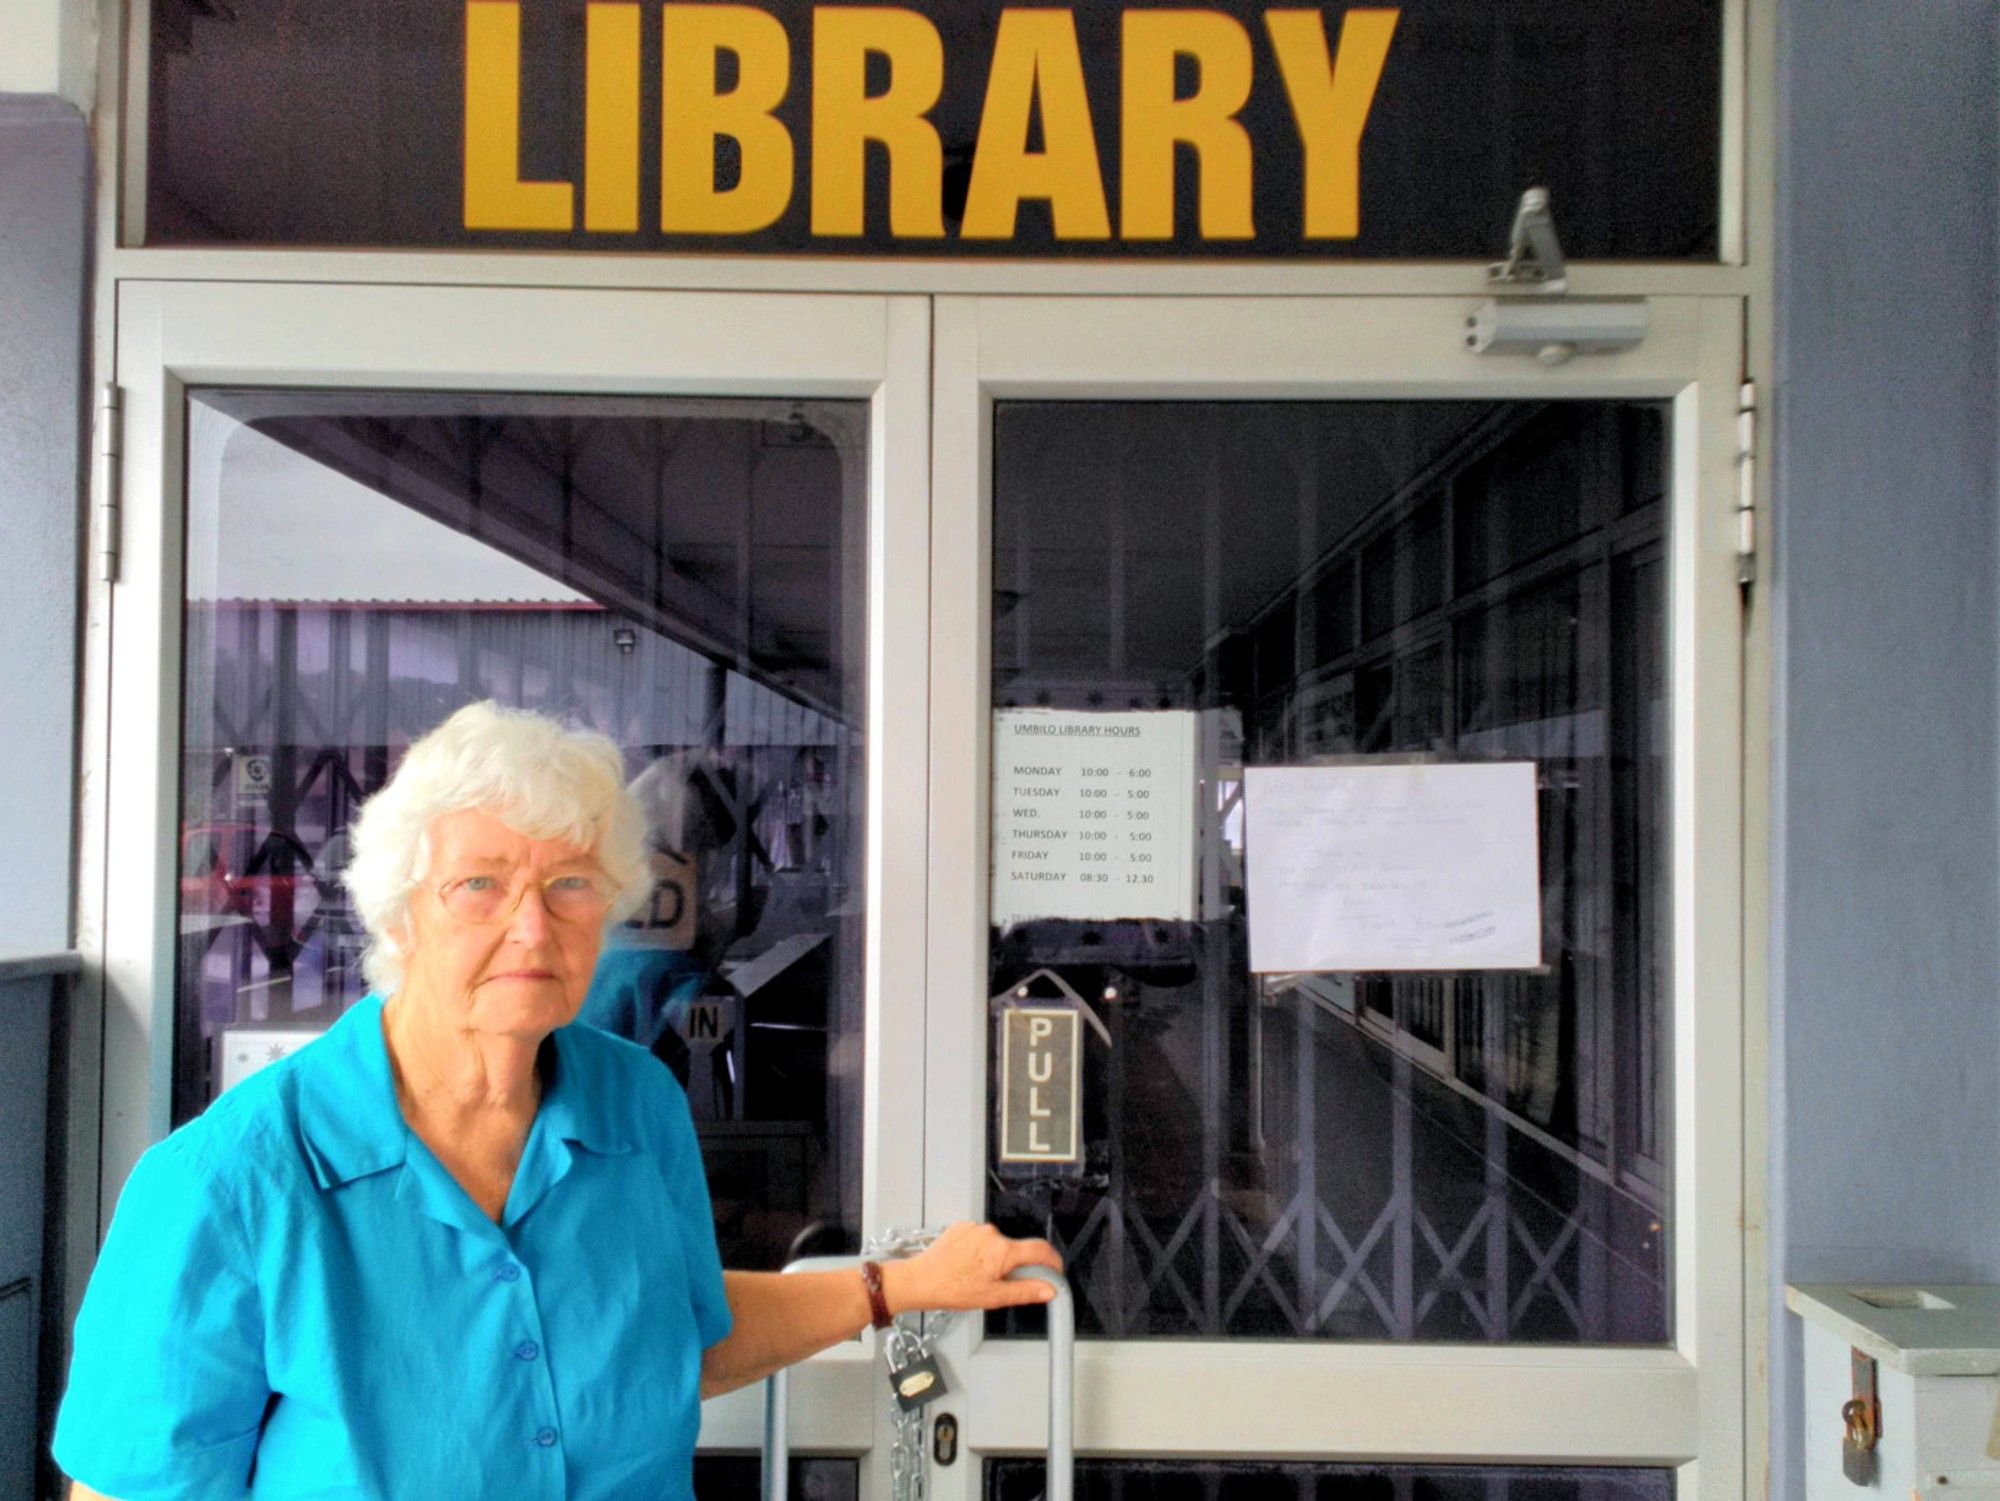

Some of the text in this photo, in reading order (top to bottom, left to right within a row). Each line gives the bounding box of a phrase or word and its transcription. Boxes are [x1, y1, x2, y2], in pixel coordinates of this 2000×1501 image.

[463, 0, 1399, 239] LIBRARY
[1014, 724, 1142, 738] UMBILO LIBRARY HOURS
[1013, 765, 1063, 776] MONDAY
[1081, 767, 1110, 777] 10:00
[1128, 768, 1152, 778] 6:00
[1013, 787, 1061, 798] TUESDAY
[1079, 788, 1108, 799] 10:00
[1127, 789, 1150, 800] 5:00
[1079, 809, 1108, 820] 10:00
[1126, 810, 1150, 821] 5:00
[1012, 829, 1068, 840] THURSDAY
[1079, 830, 1107, 841] 10:00
[1129, 831, 1152, 842] 5:00
[1011, 850, 1050, 860] FRIDAY
[1079, 851, 1107, 862] 10:00
[1129, 852, 1152, 863] 5:00
[1011, 871, 1067, 882] SATURDAY
[688, 1006, 718, 1039] IN
[1028, 1017, 1053, 1151] PULL
